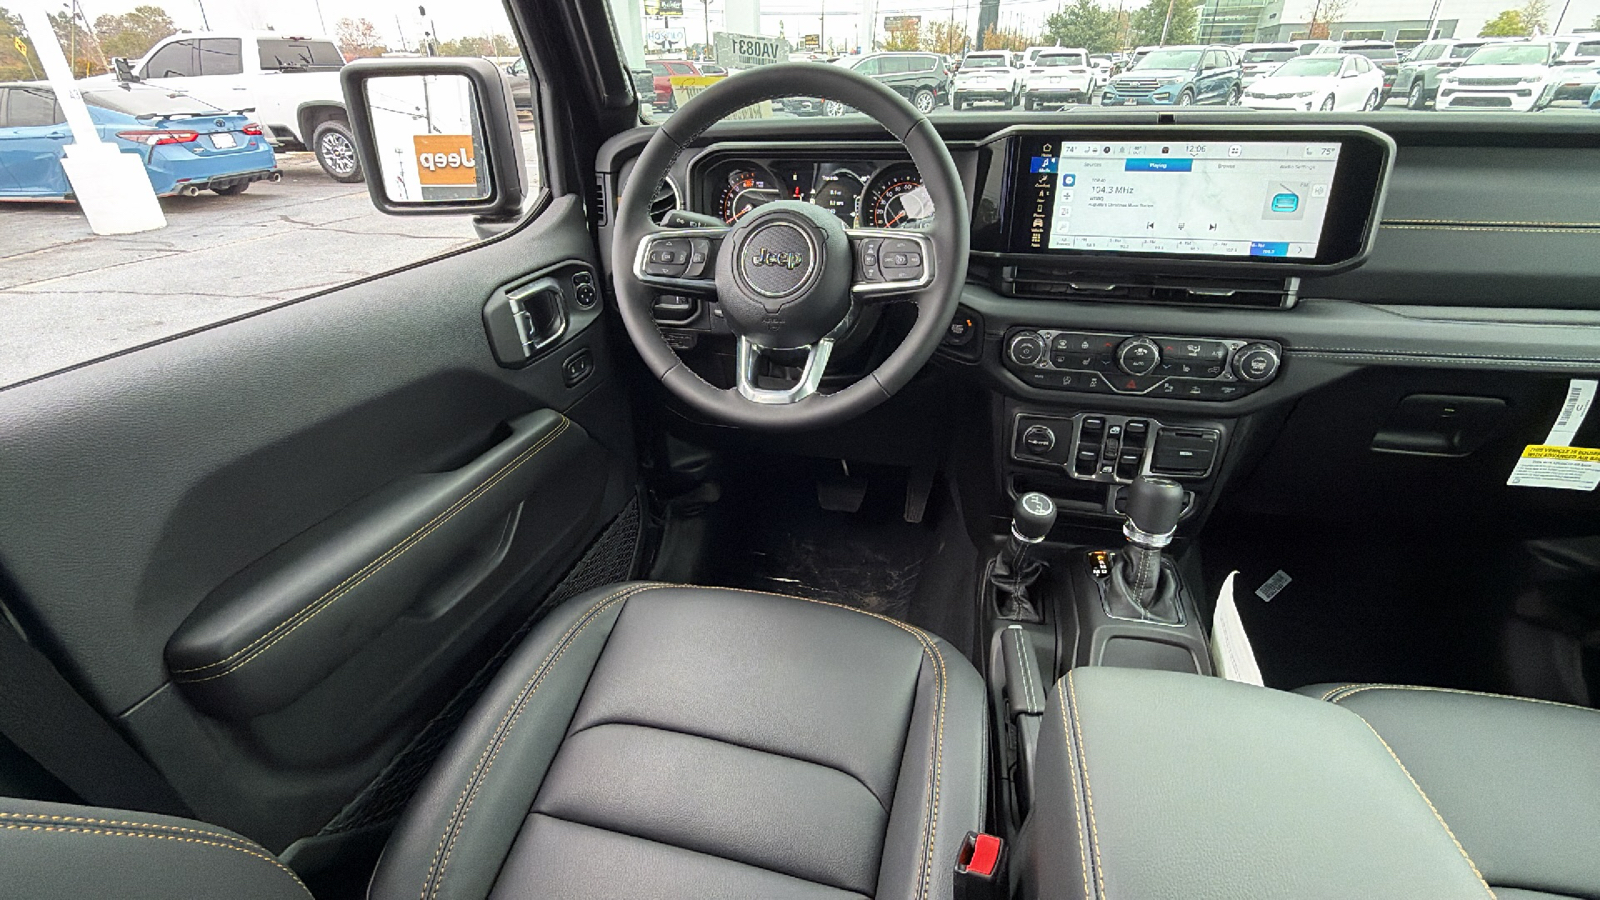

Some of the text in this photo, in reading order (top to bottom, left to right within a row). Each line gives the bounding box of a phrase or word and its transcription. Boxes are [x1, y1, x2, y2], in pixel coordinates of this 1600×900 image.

[1185, 145, 1206, 153] 12:06
[1091, 186, 1134, 194] 104.3 MHz
[752, 247, 802, 270] Jeep
